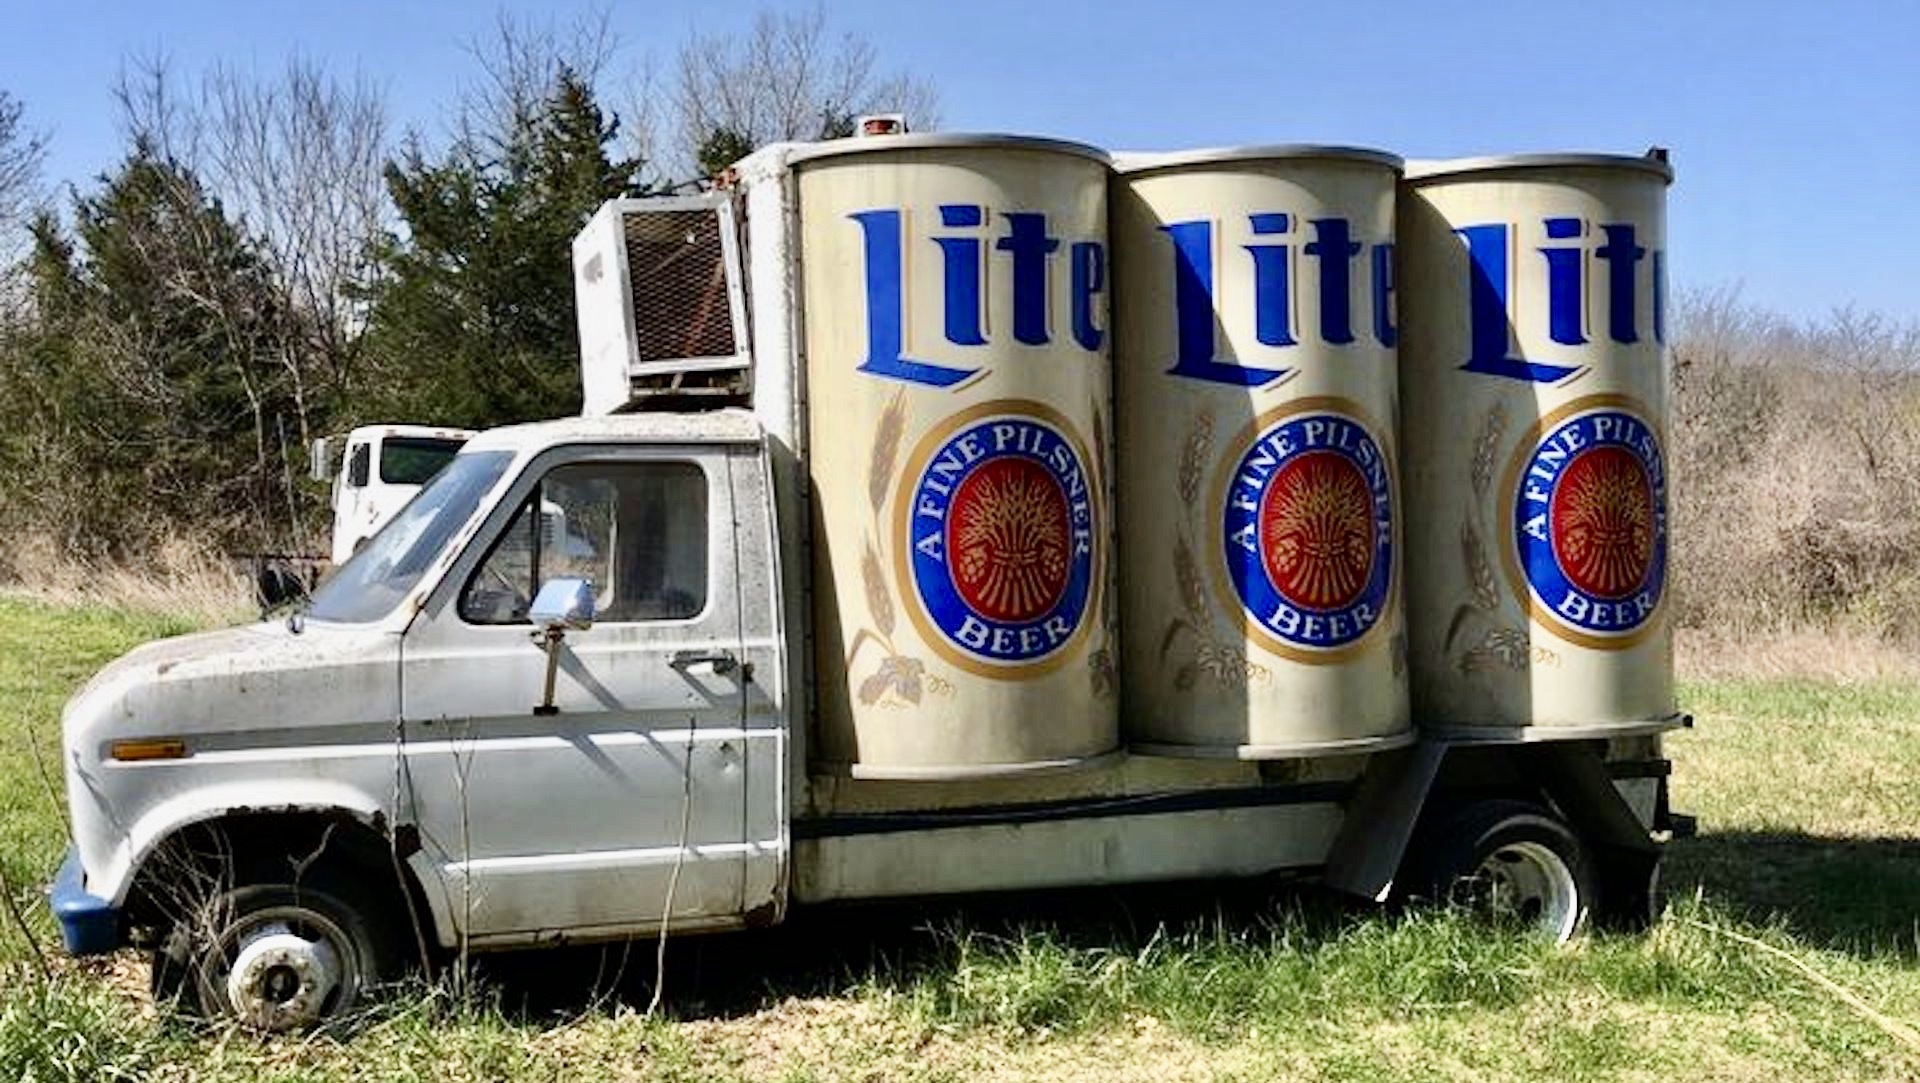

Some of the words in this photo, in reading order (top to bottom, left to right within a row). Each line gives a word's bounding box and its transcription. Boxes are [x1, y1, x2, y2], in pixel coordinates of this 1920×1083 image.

[846, 205, 1105, 388] Lite
[919, 434, 985, 524] FINE
[1231, 427, 1297, 517] FINE
[1522, 420, 1587, 507] FINE
[995, 424, 1091, 555] PILSNER
[916, 533, 943, 561] A
[1231, 527, 1257, 553] A
[1522, 513, 1548, 542] A
[1266, 601, 1377, 641] BEER
[1557, 589, 1656, 627] BEER
[955, 614, 1071, 655] BEER
